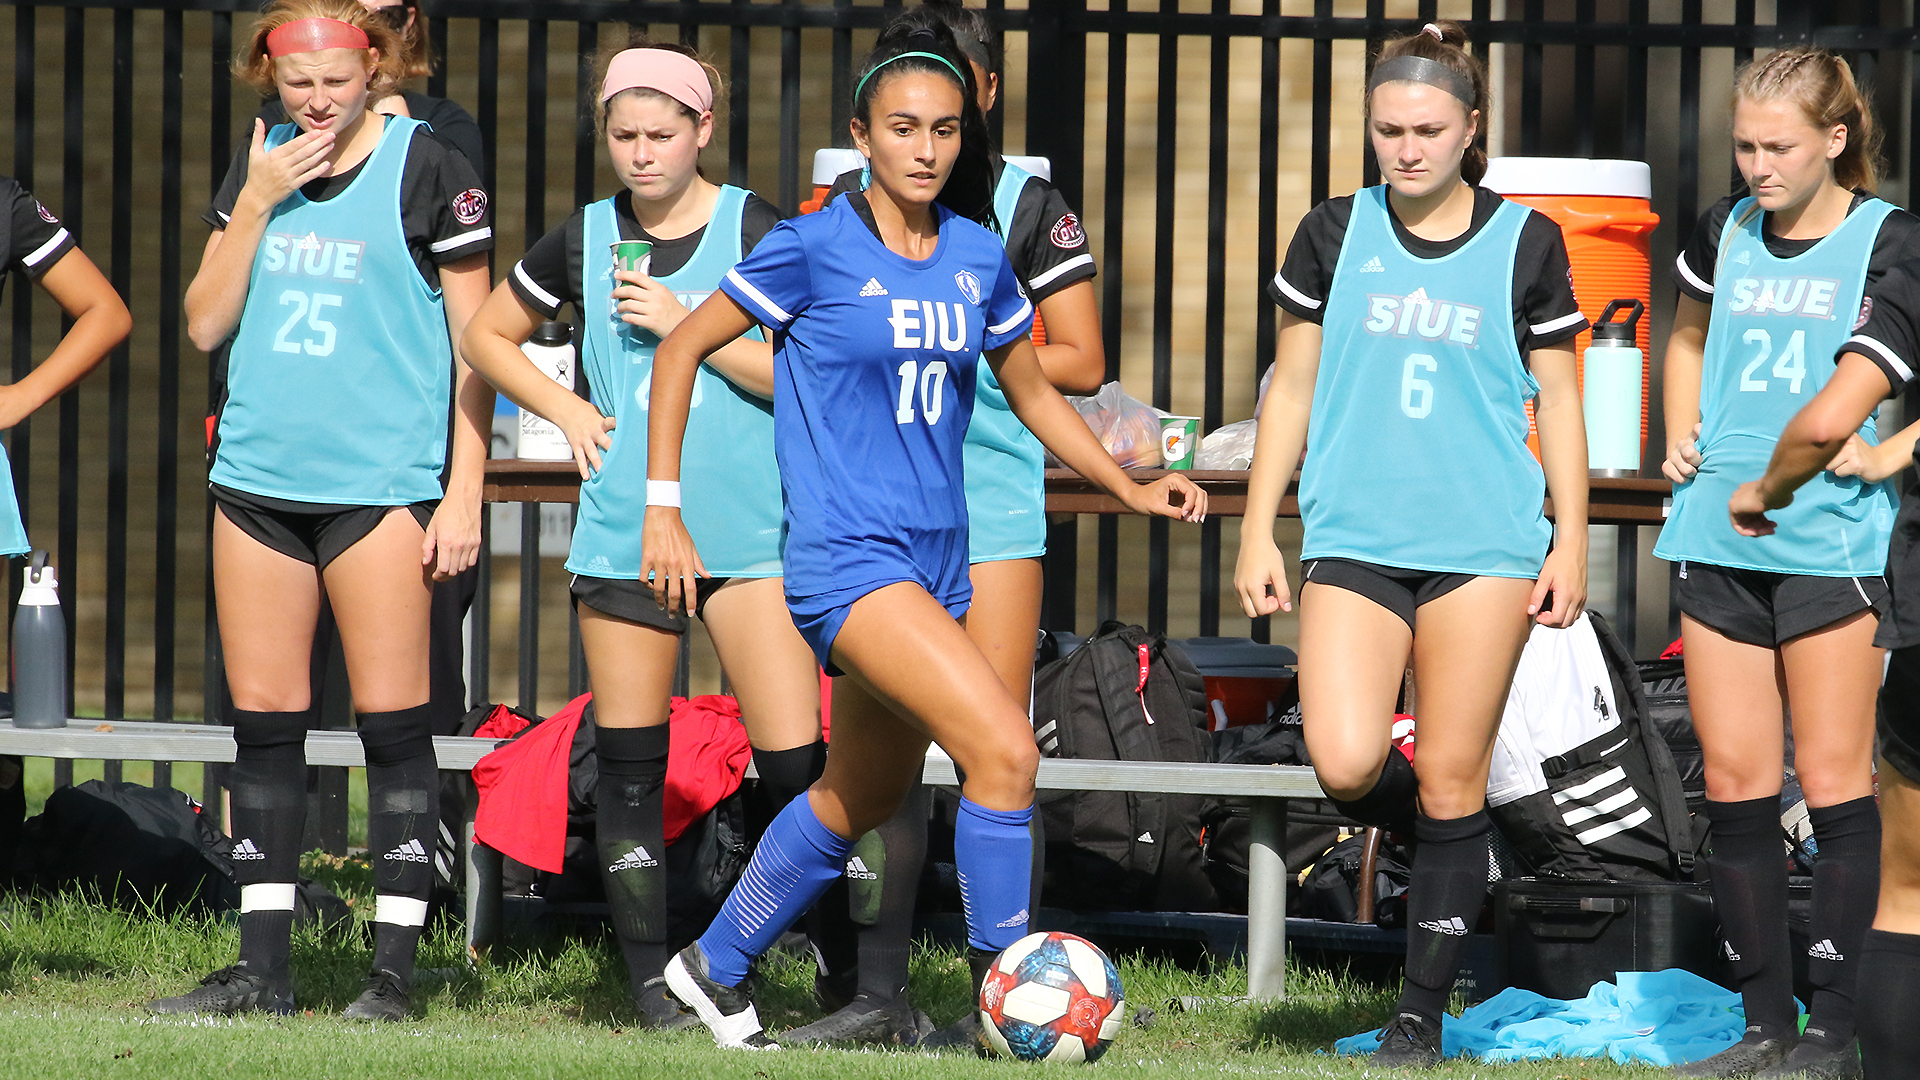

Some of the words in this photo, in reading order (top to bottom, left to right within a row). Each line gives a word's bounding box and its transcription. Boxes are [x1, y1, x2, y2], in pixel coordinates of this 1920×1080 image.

[263, 235, 361, 280] SIUE
[1728, 278, 1838, 316] SIUE
[272, 289, 343, 358] 25
[1365, 297, 1481, 345] SIUE
[1739, 328, 1807, 395] 24
[896, 360, 948, 426] 10
[1400, 353, 1438, 420] 6
[522, 428, 555, 436] patagonia
[384, 851, 429, 864] adidas
[608, 859, 658, 874] adidas
[1418, 921, 1469, 937] adidas
[1808, 948, 1844, 961] adidas
